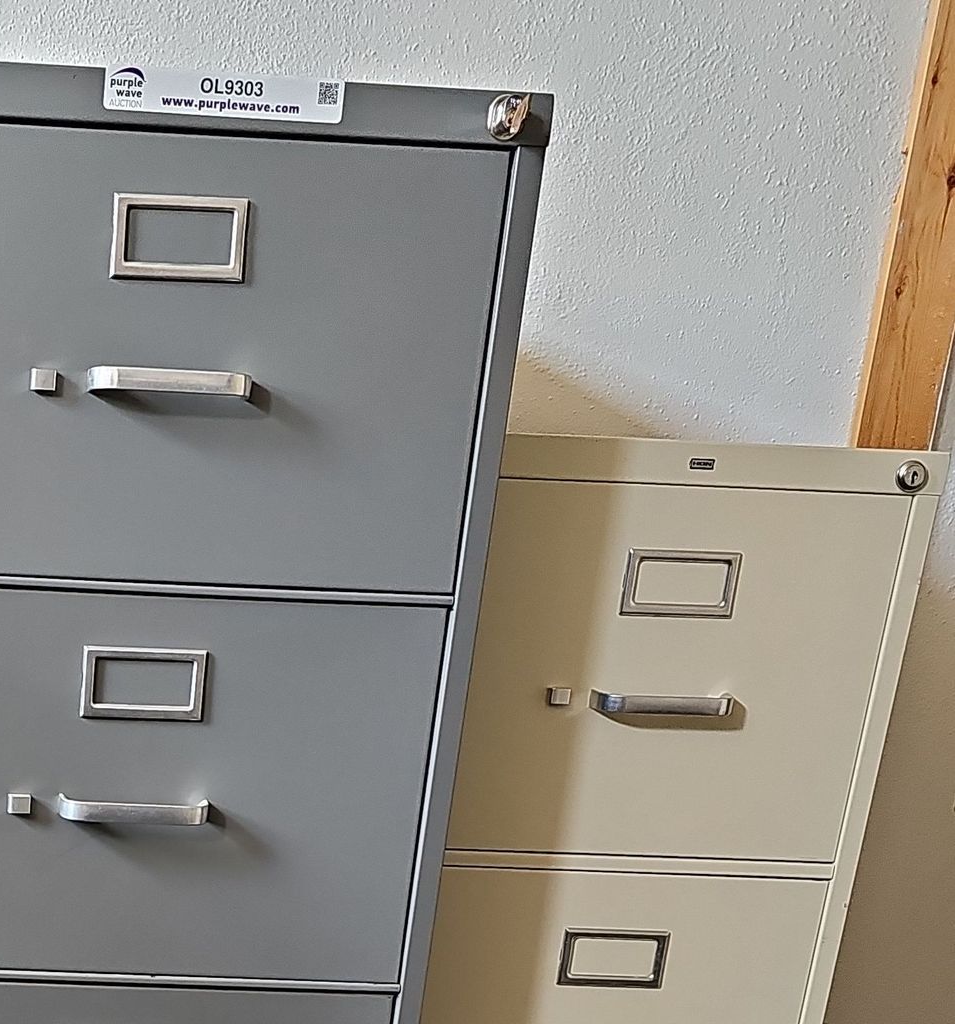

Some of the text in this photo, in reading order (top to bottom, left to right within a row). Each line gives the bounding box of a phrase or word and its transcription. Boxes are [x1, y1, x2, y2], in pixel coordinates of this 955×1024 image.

[110, 76, 144, 89] purple
[200, 77, 264, 97] OL9303
[116, 88, 143, 98] wave
[109, 98, 143, 109] AUCTION
[162, 97, 300, 115] www.purplewave.com
